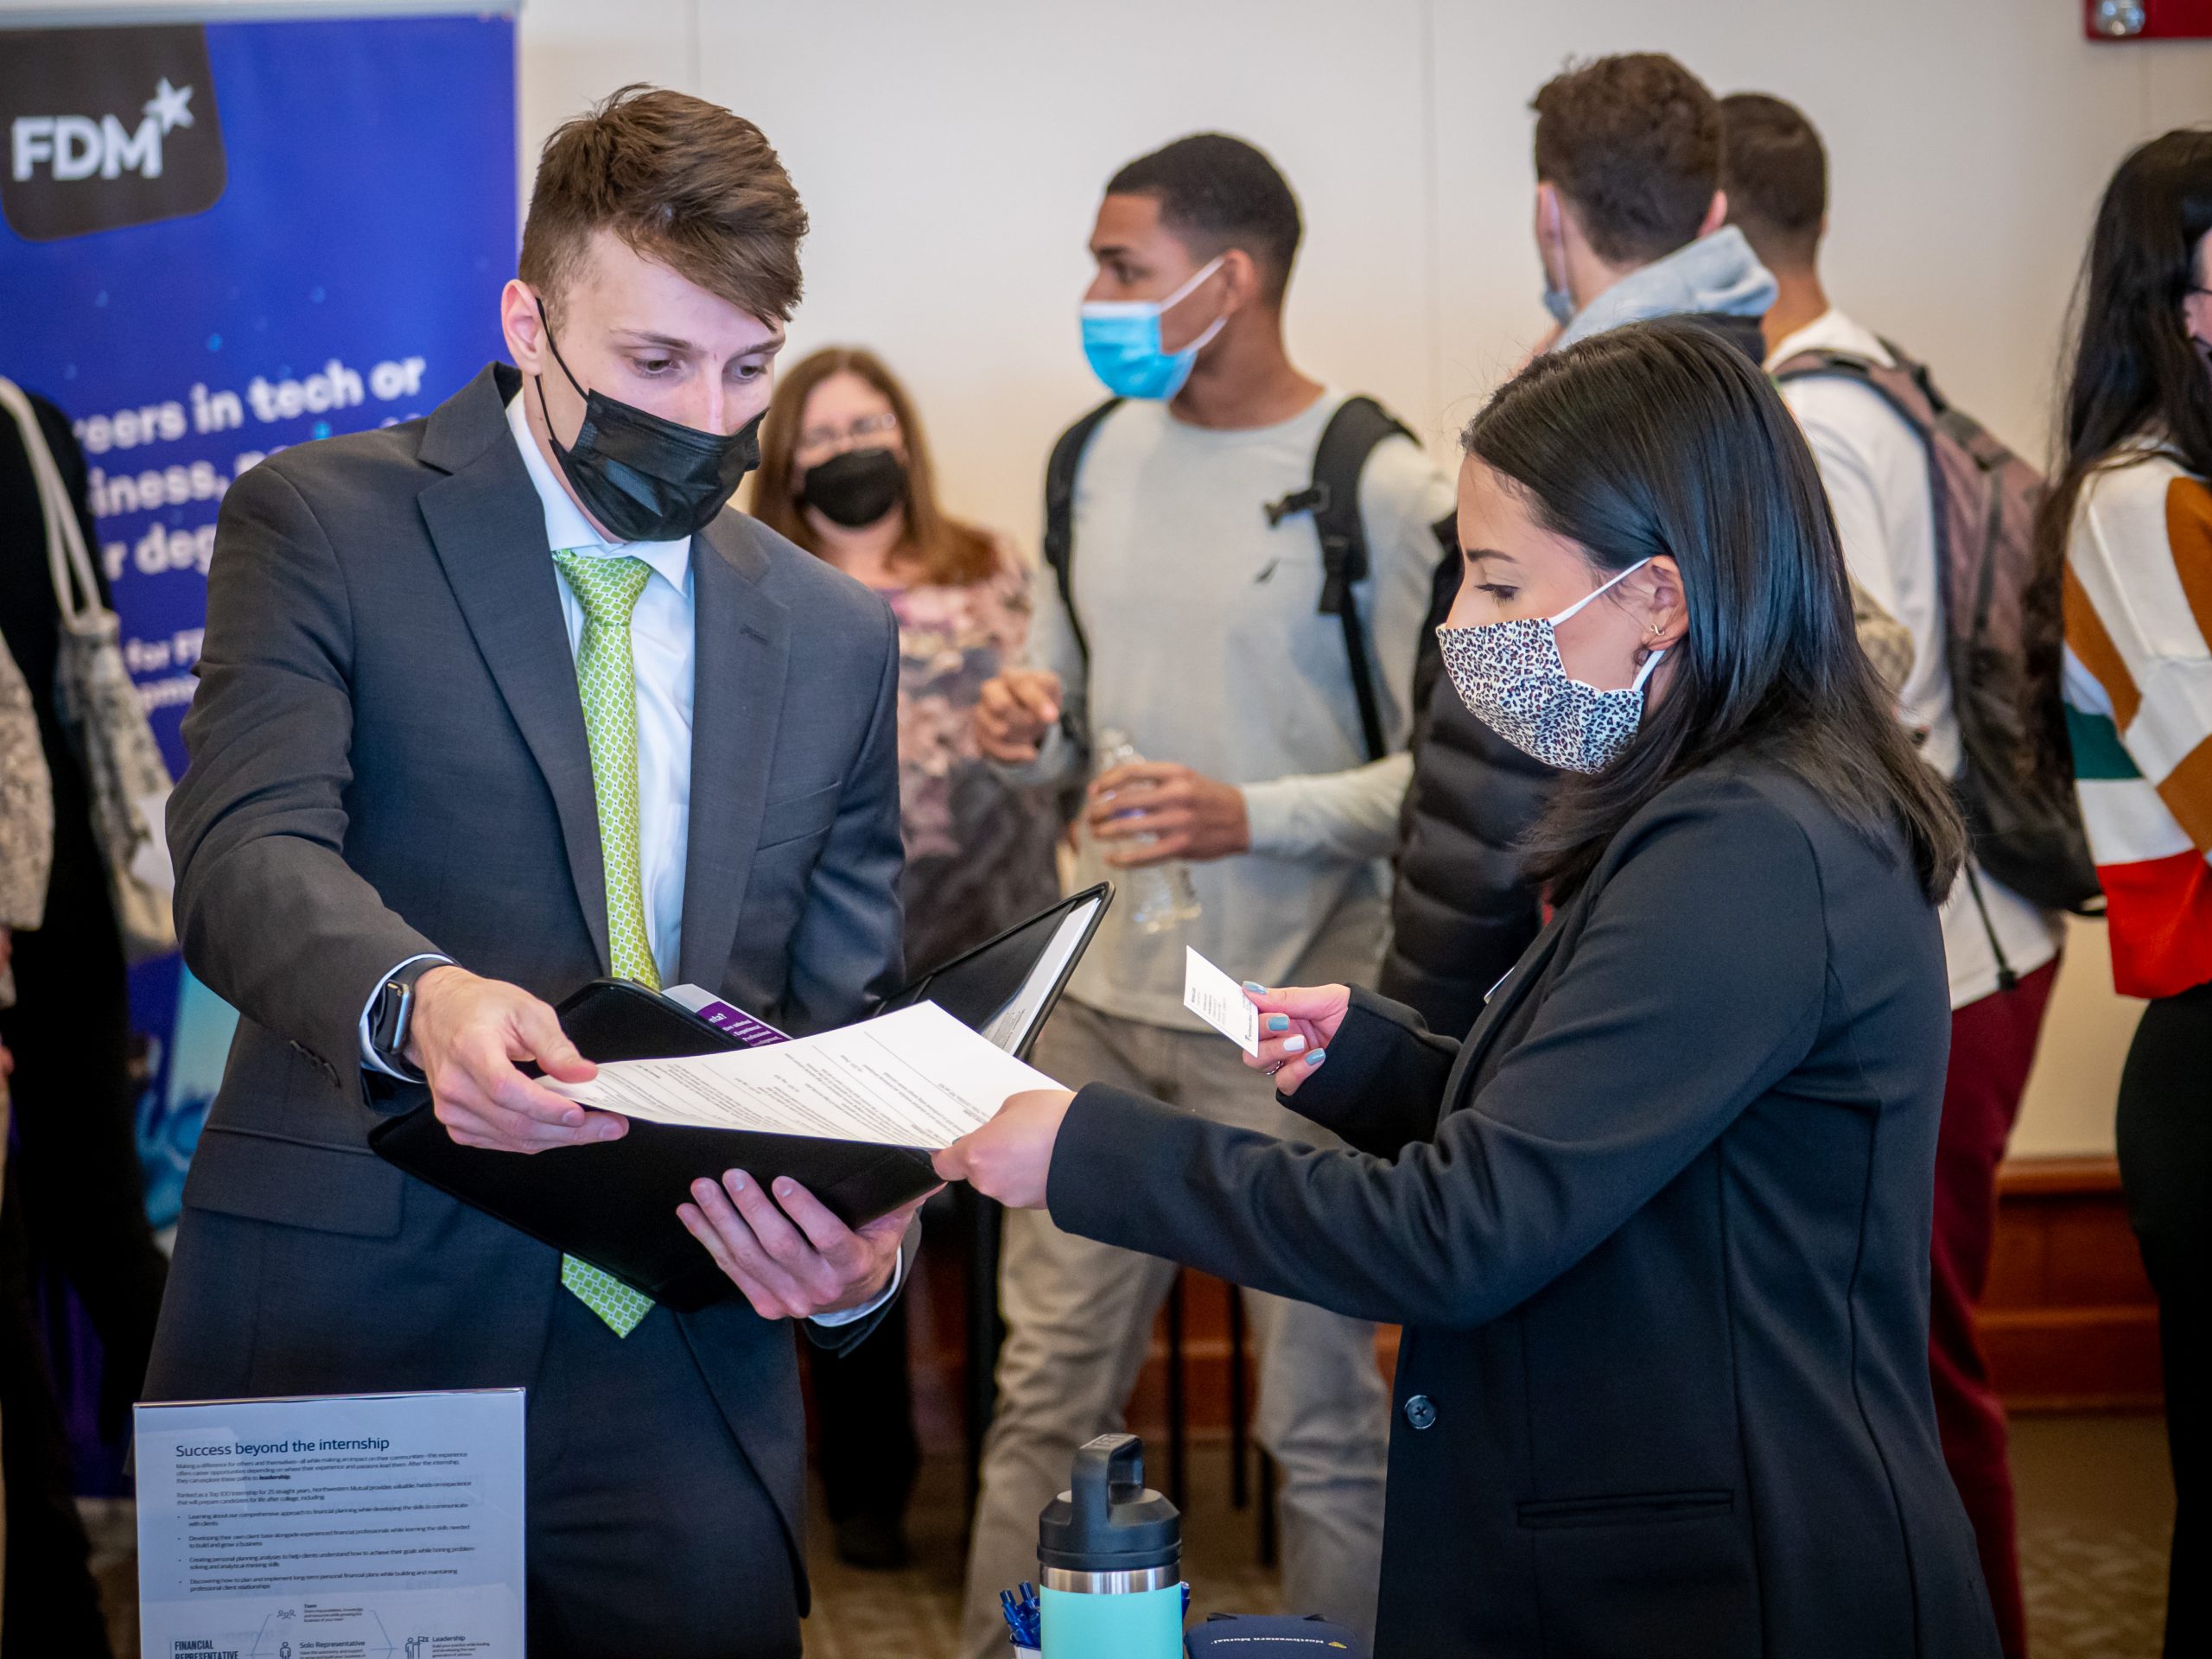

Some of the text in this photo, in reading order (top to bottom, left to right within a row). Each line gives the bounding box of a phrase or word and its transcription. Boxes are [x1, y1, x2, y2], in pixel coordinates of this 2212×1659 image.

[12, 113, 162, 181] FDM
[190, 382, 245, 434] in
[247, 358, 364, 423] tech
[369, 356, 425, 402] or
[175, 1437, 390, 1457] Success beyond the internship
[175, 1640, 214, 1650] FINANCIAL
[175, 1650, 238, 1659] REPRESENTATIVE
